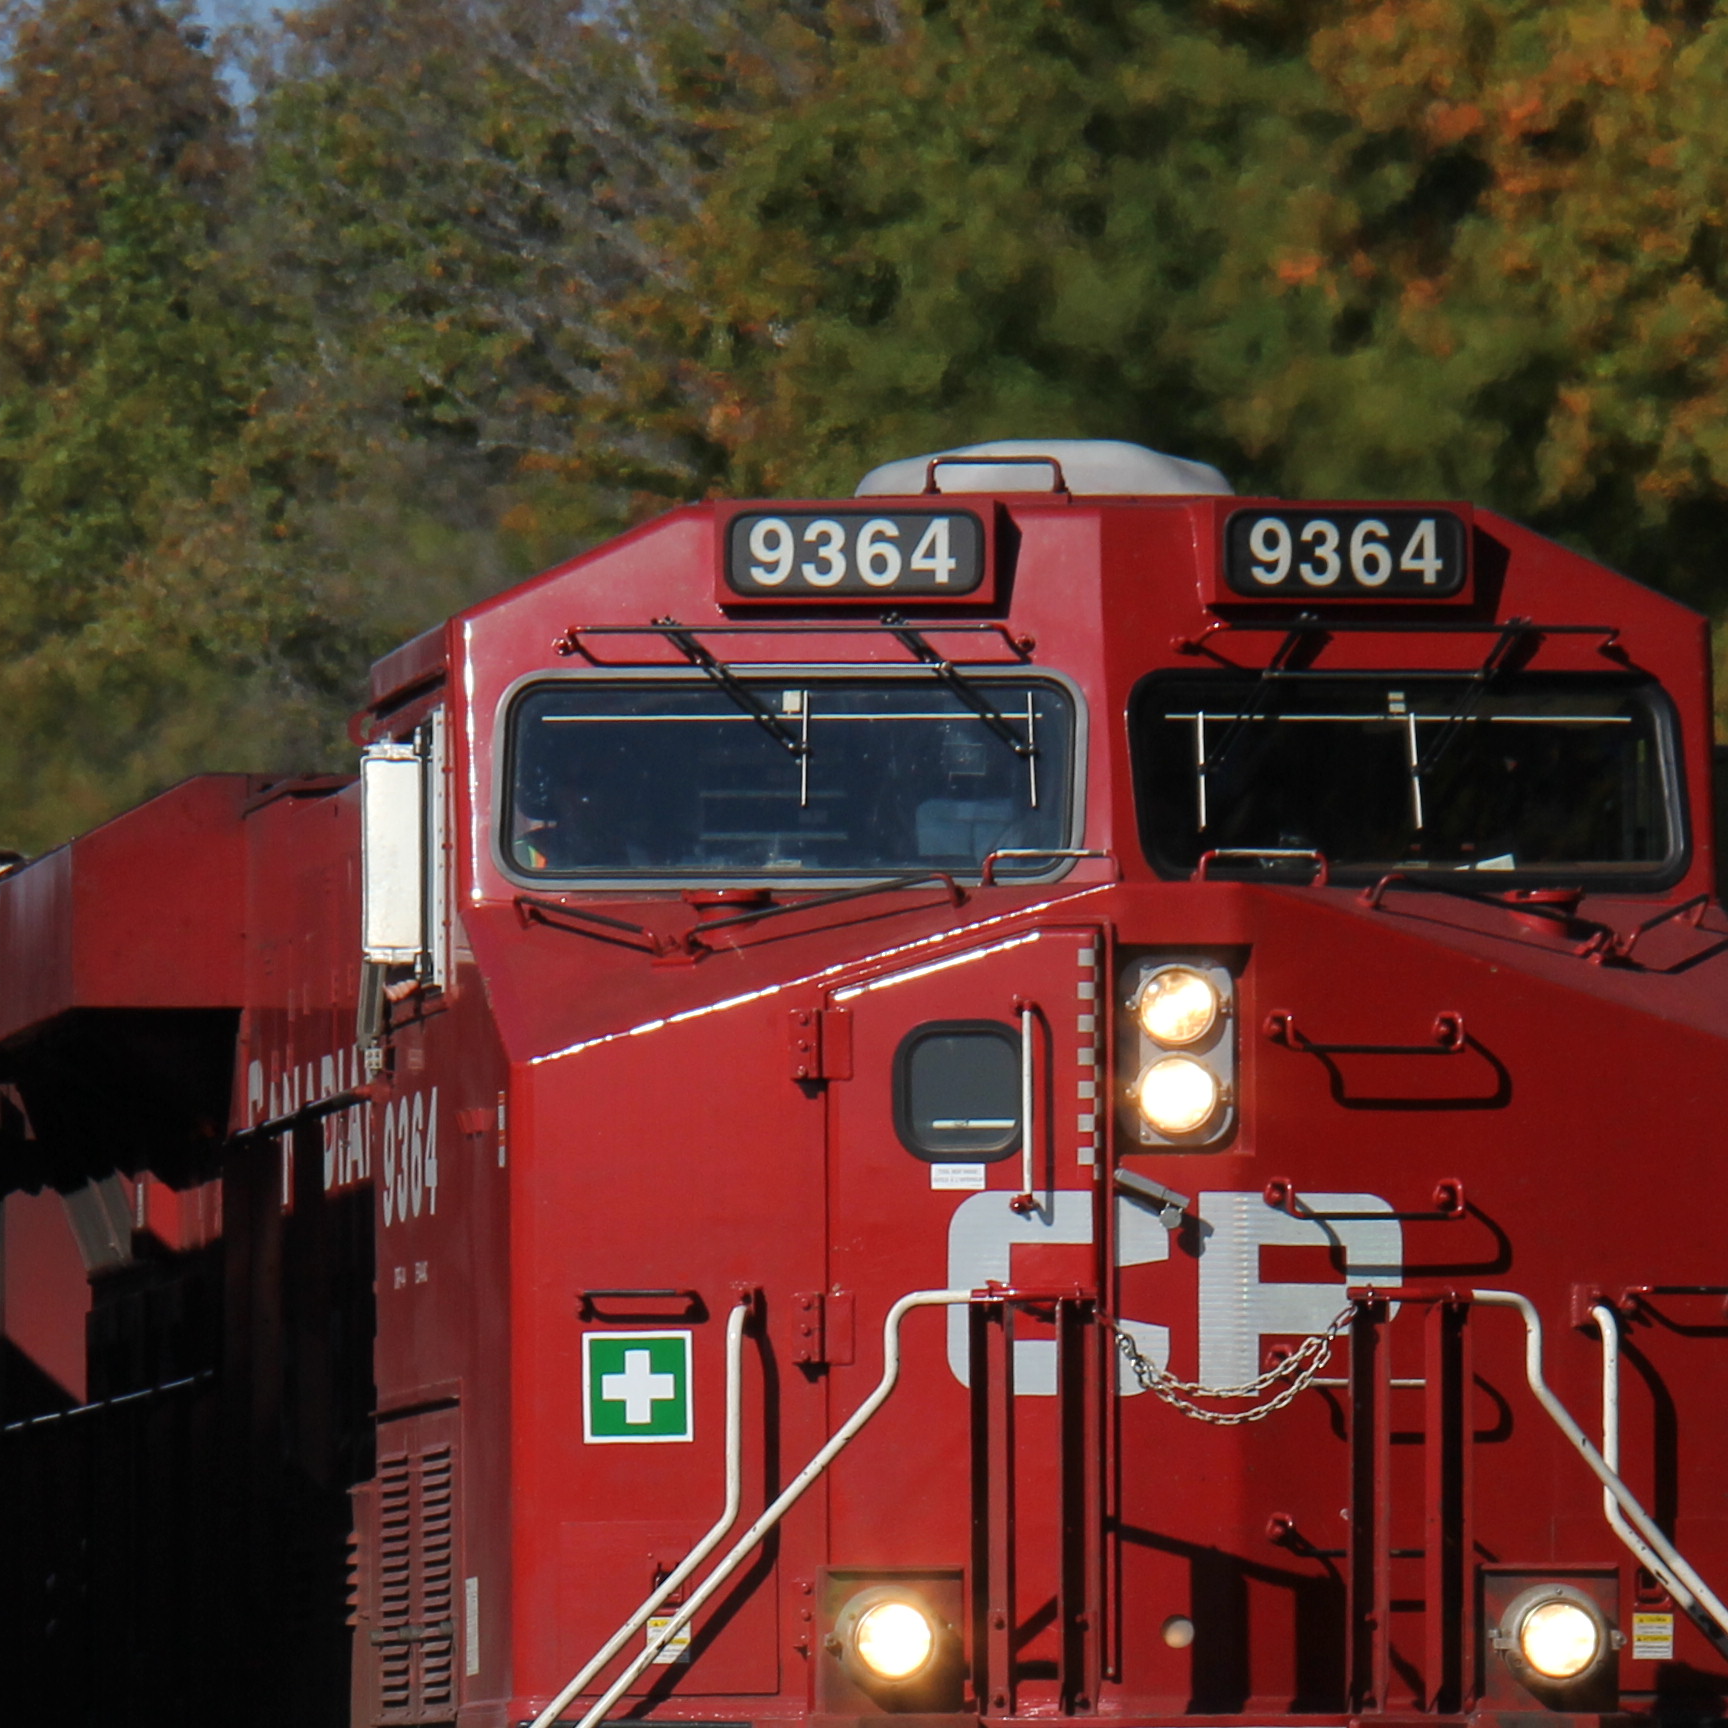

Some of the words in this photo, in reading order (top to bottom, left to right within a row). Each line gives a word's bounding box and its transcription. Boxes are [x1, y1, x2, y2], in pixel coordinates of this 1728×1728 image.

[749, 518, 956, 587] 9364
[1250, 518, 1442, 587] 9364
[383, 1086, 438, 1228] 9364
[946, 1190, 1404, 1397] CP
